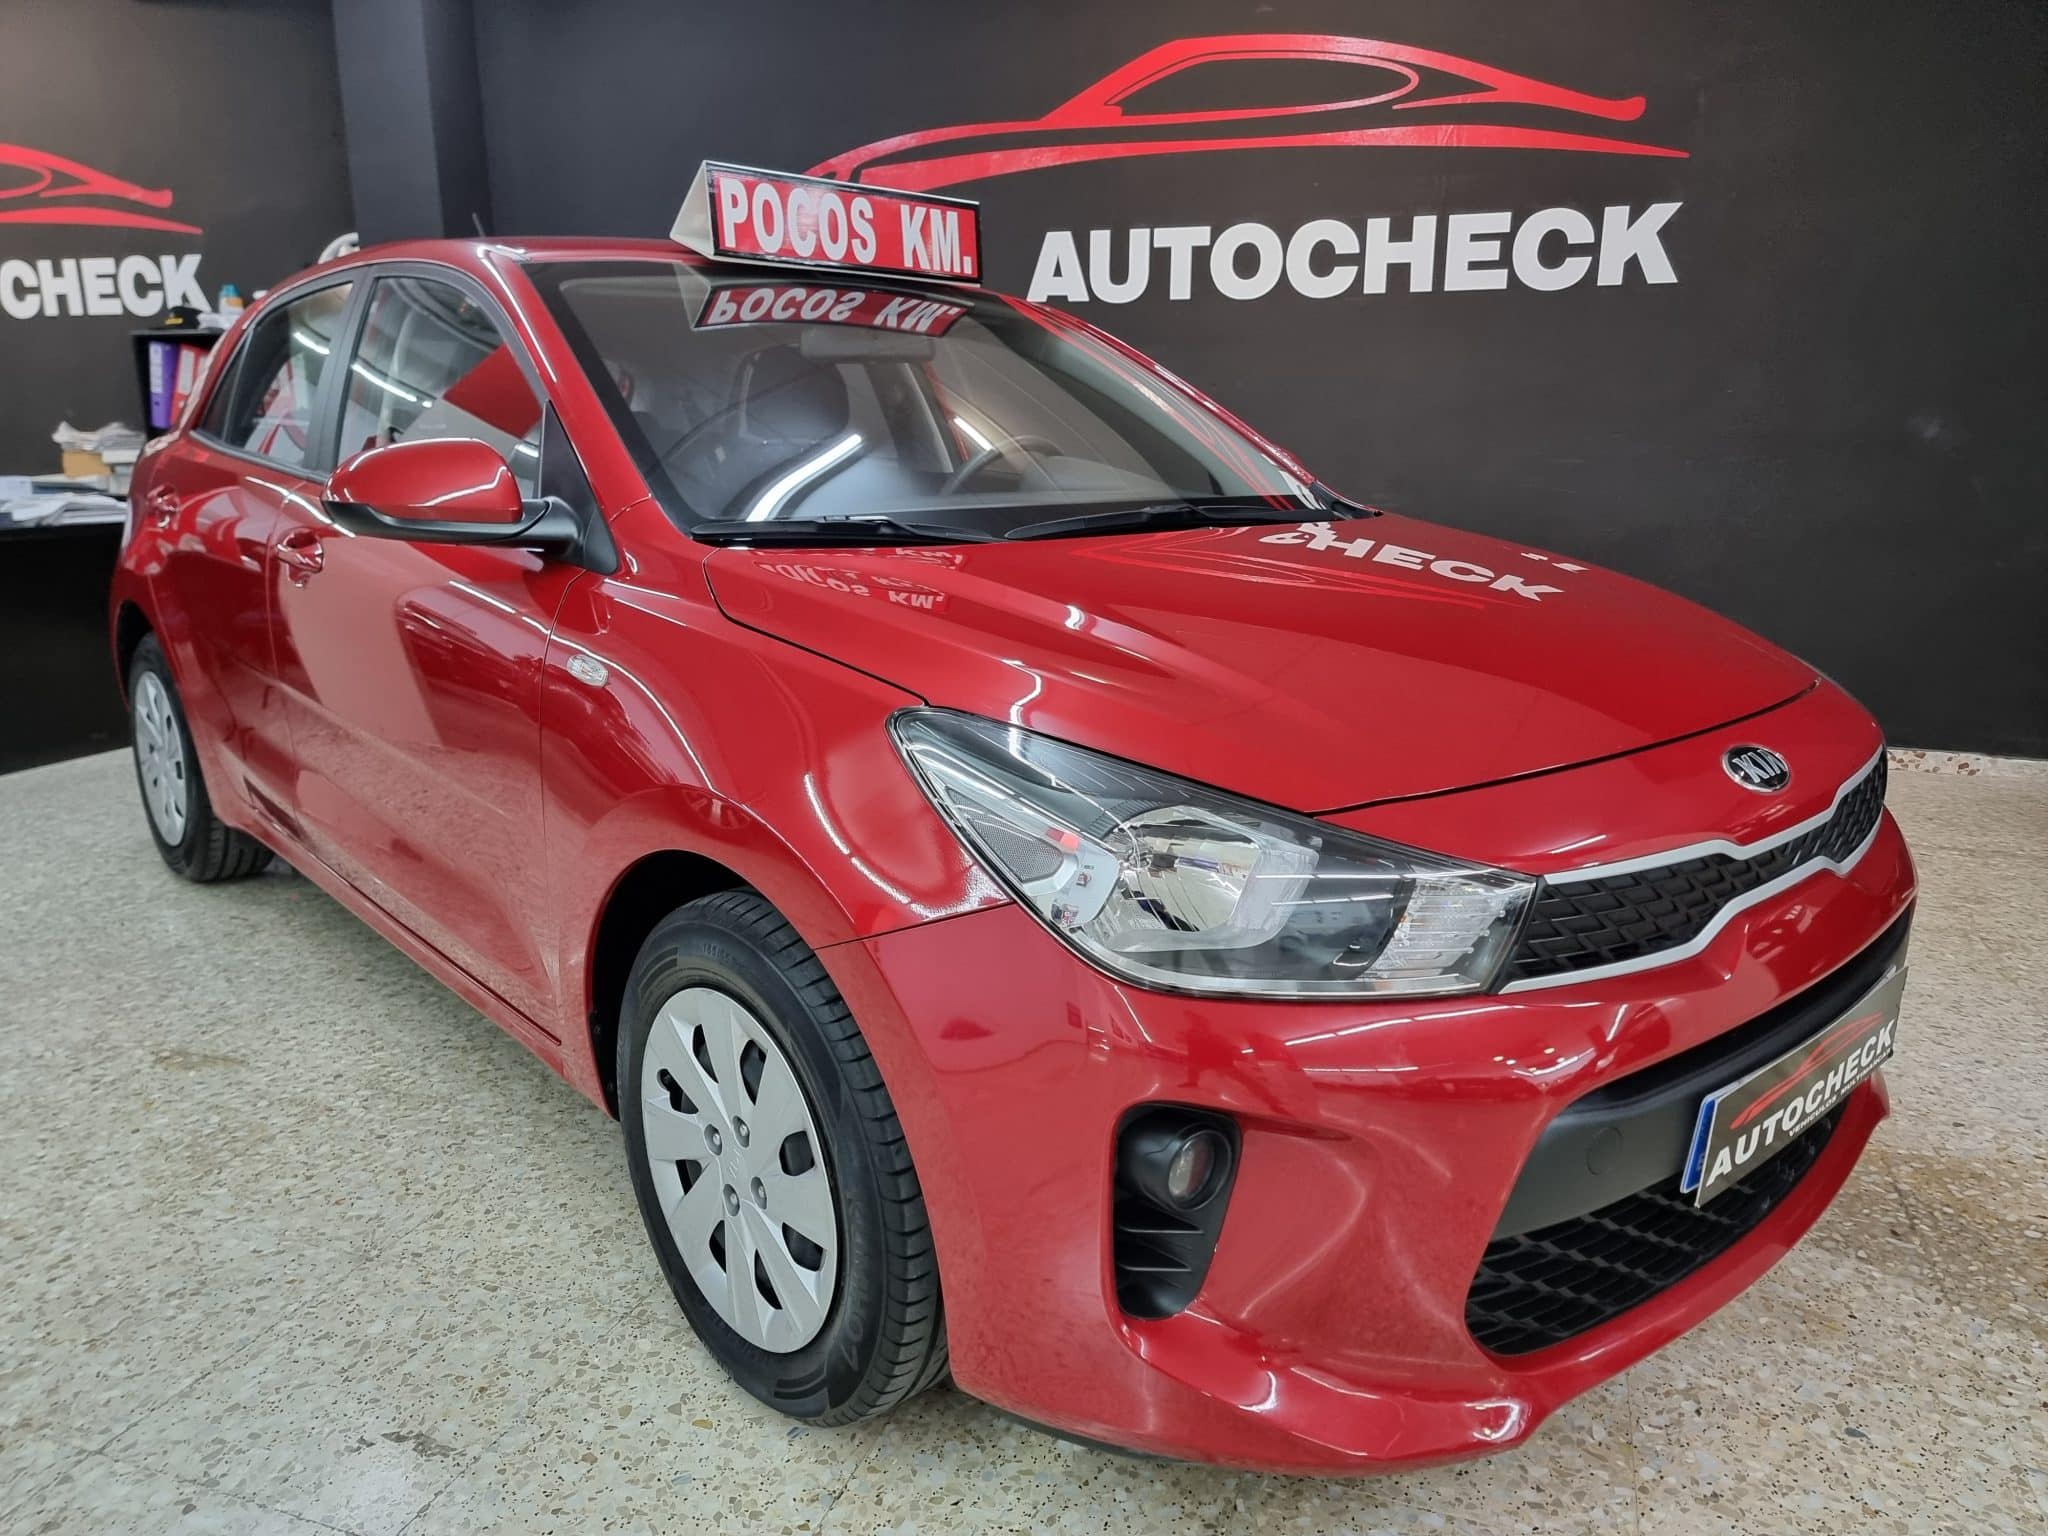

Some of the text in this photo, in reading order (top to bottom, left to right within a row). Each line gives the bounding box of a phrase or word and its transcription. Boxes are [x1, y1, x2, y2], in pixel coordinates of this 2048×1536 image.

[718, 176, 973, 275] POCOS KM.
[1026, 201, 1684, 304] AUTOCHECK
[0, 253, 213, 320] CHECK
[1731, 749, 1787, 783] KIA
[1705, 1018, 1896, 1187] AUTOCHECK
